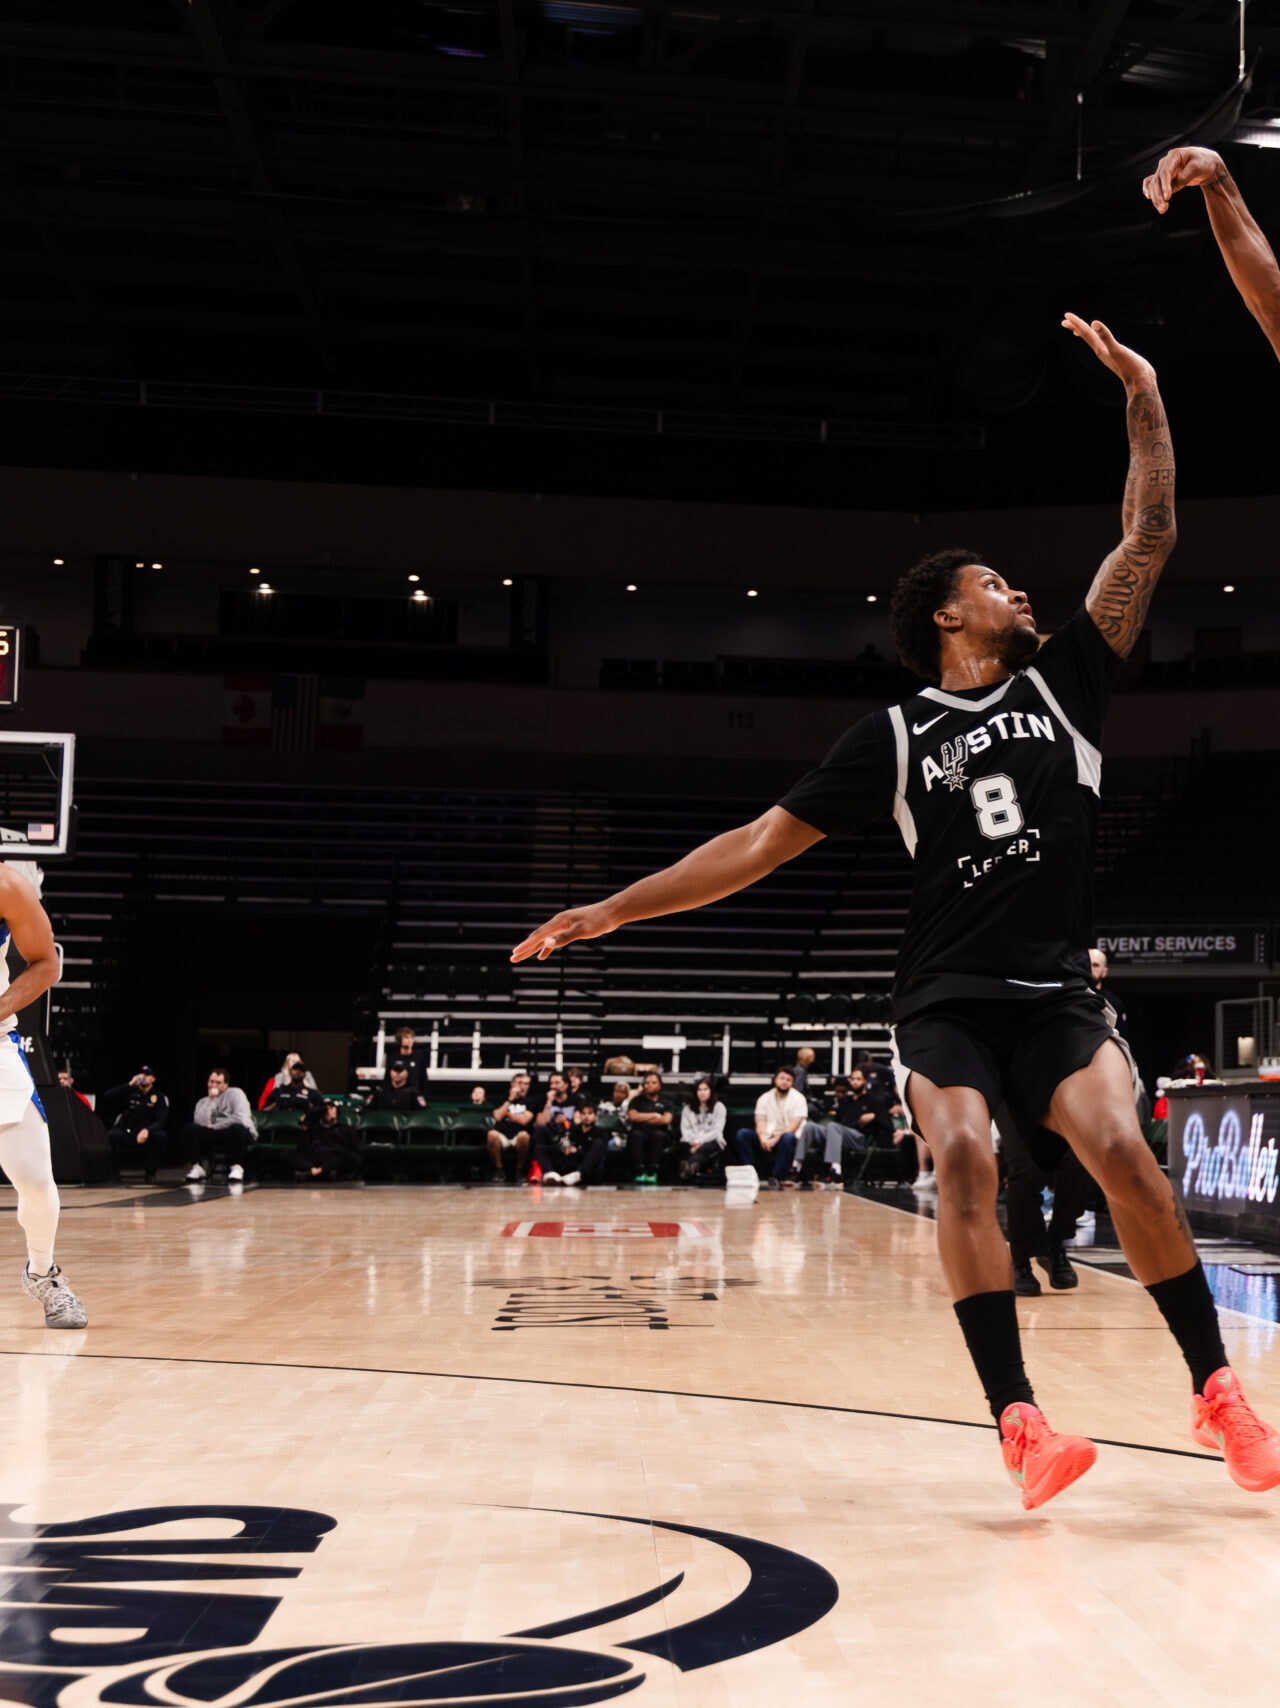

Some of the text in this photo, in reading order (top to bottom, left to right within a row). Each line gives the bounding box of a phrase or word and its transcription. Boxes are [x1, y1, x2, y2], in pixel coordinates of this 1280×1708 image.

[727, 711, 755, 729] 113
[969, 772, 1026, 841] 8
[971, 838, 1029, 878] LEER
[1096, 935, 1237, 953] EVENT SERVICES
[1182, 1108, 1280, 1204] ProBaller
